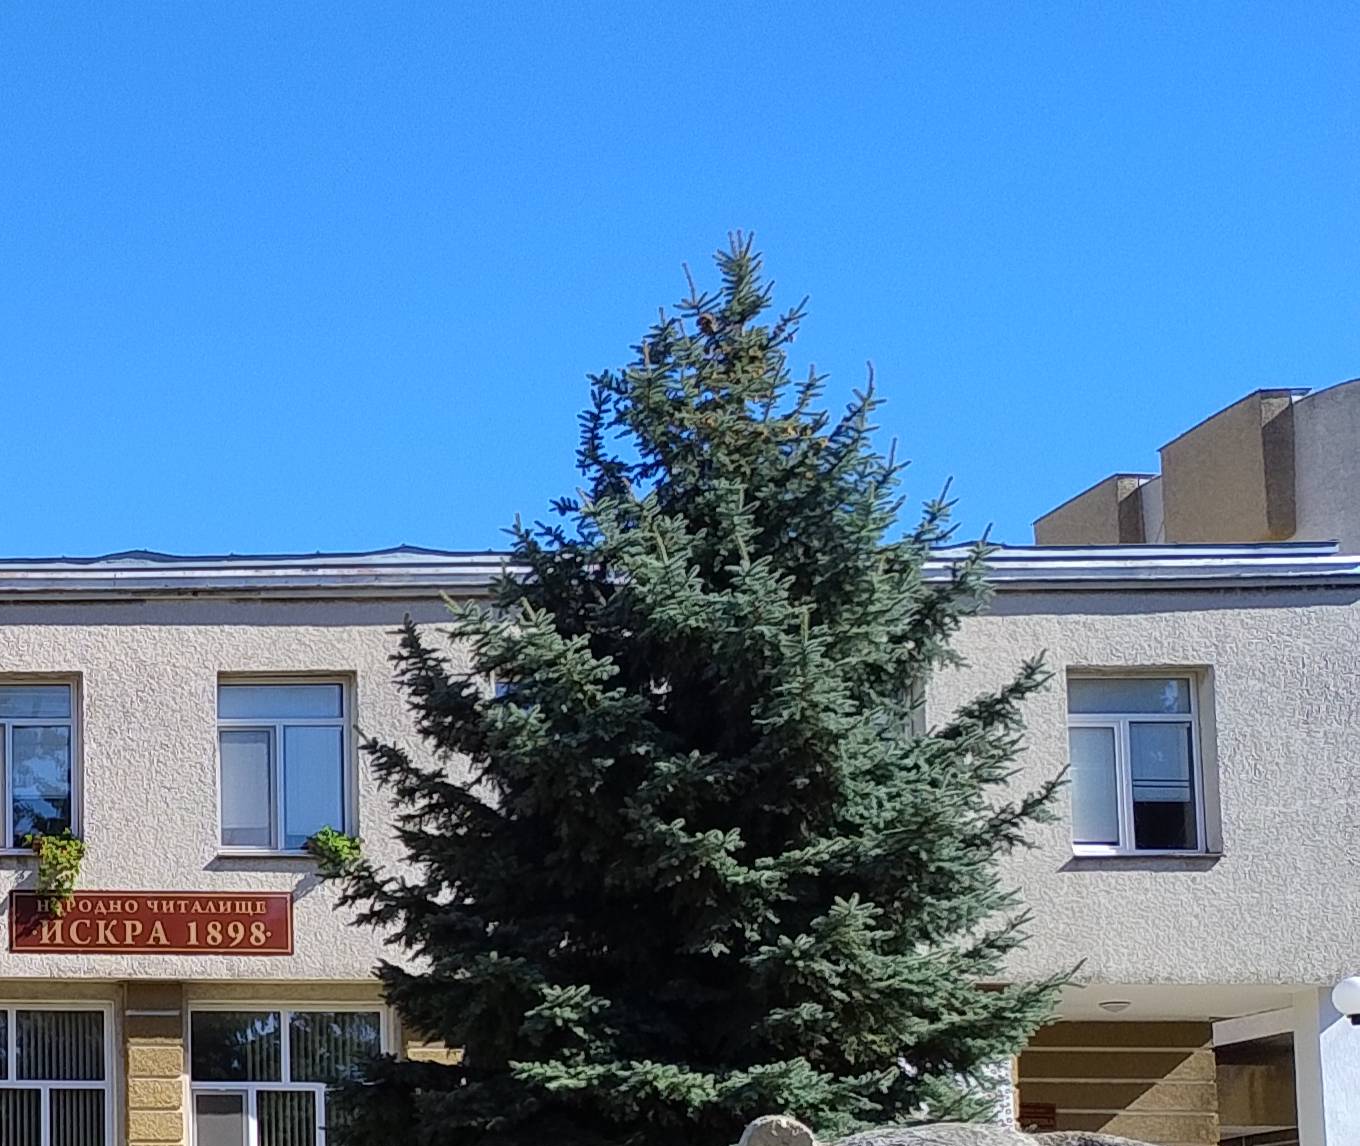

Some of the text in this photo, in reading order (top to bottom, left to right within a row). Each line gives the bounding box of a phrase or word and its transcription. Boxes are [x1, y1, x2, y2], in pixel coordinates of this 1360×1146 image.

[146, 900, 267, 916] ЧИТАЛИЩЕ
[40, 919, 266, 947] ИСКРА 1898
